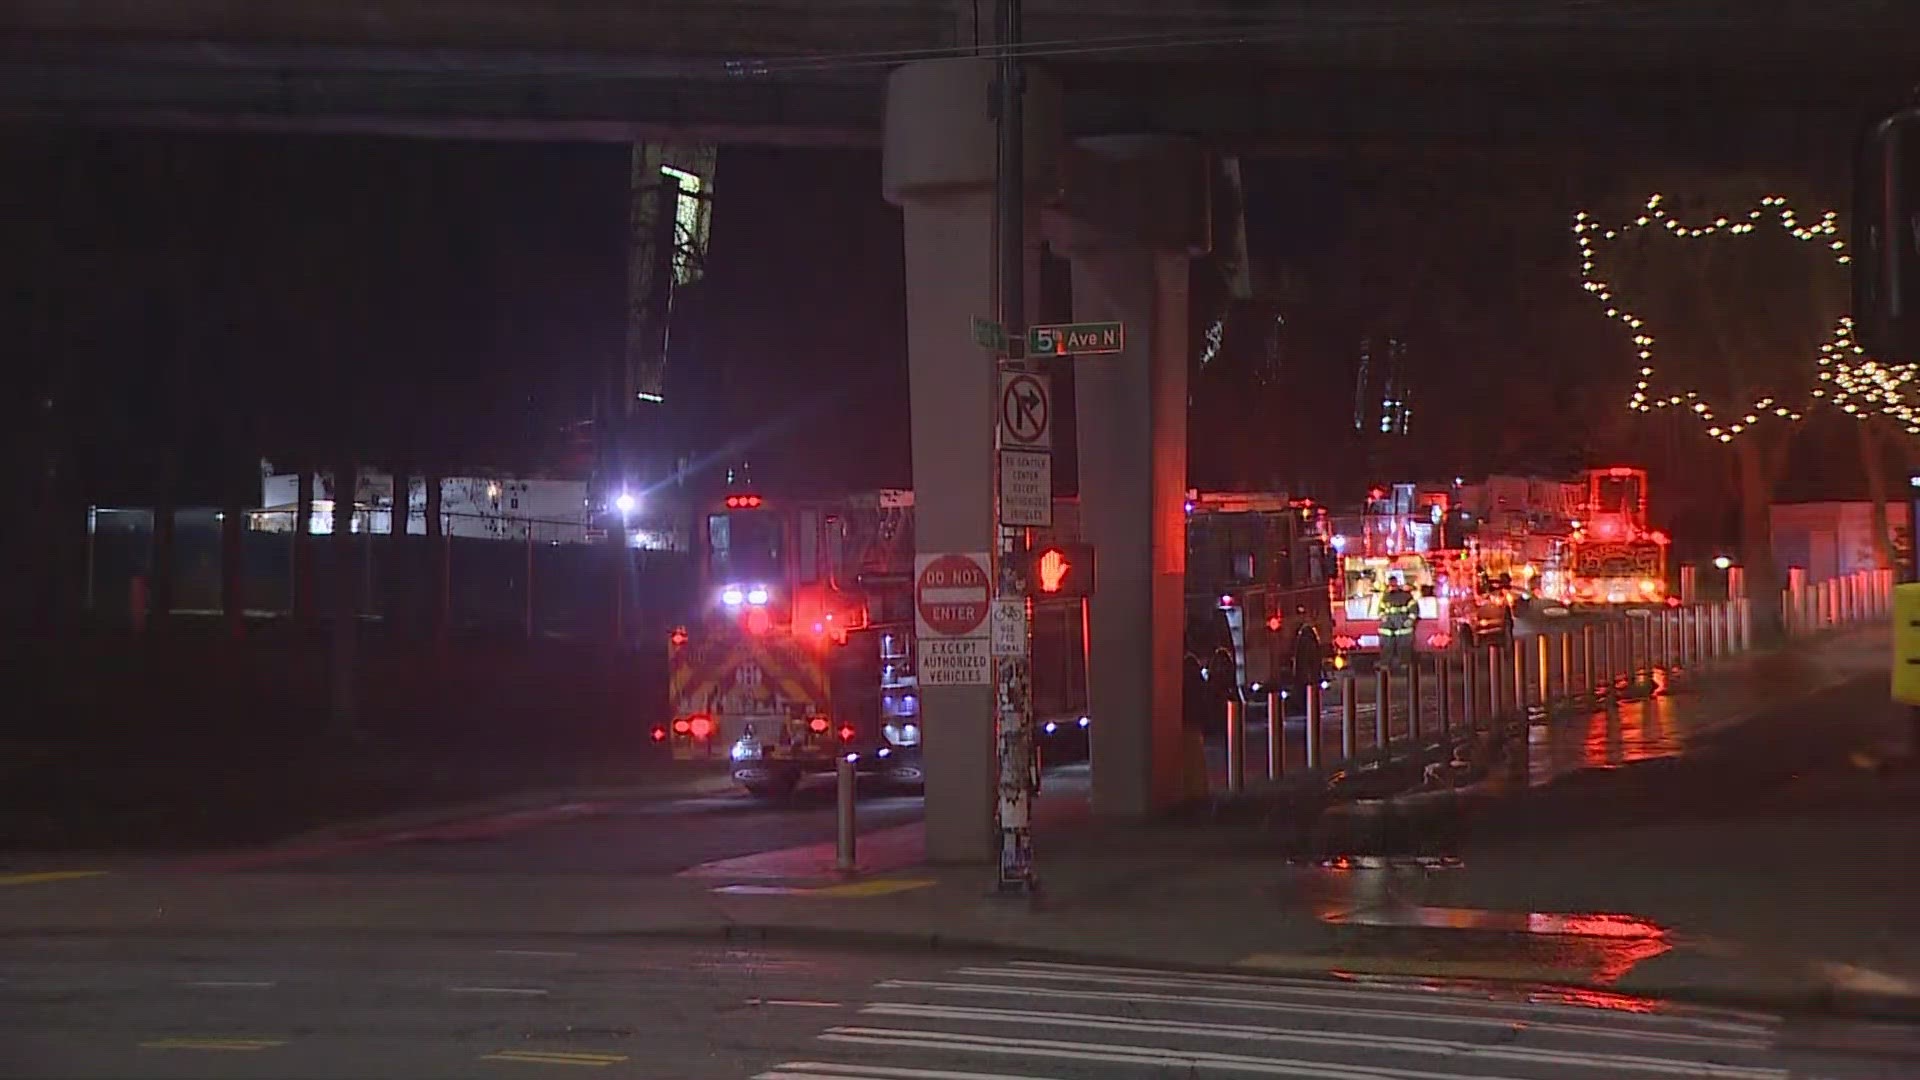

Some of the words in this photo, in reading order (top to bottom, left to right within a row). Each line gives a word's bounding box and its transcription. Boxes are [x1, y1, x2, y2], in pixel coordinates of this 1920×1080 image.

[1068, 332, 1097, 346] Ave
[1104, 330, 1114, 345] N
[1012, 470, 1039, 480] CENTER
[926, 569, 944, 584] DO
[953, 568, 979, 584] NOT
[933, 607, 975, 620] ENTER
[932, 643, 976, 654] EXCEPT
[924, 655, 986, 668] AUTHORIZED
[929, 670, 981, 682] VEHICLES
